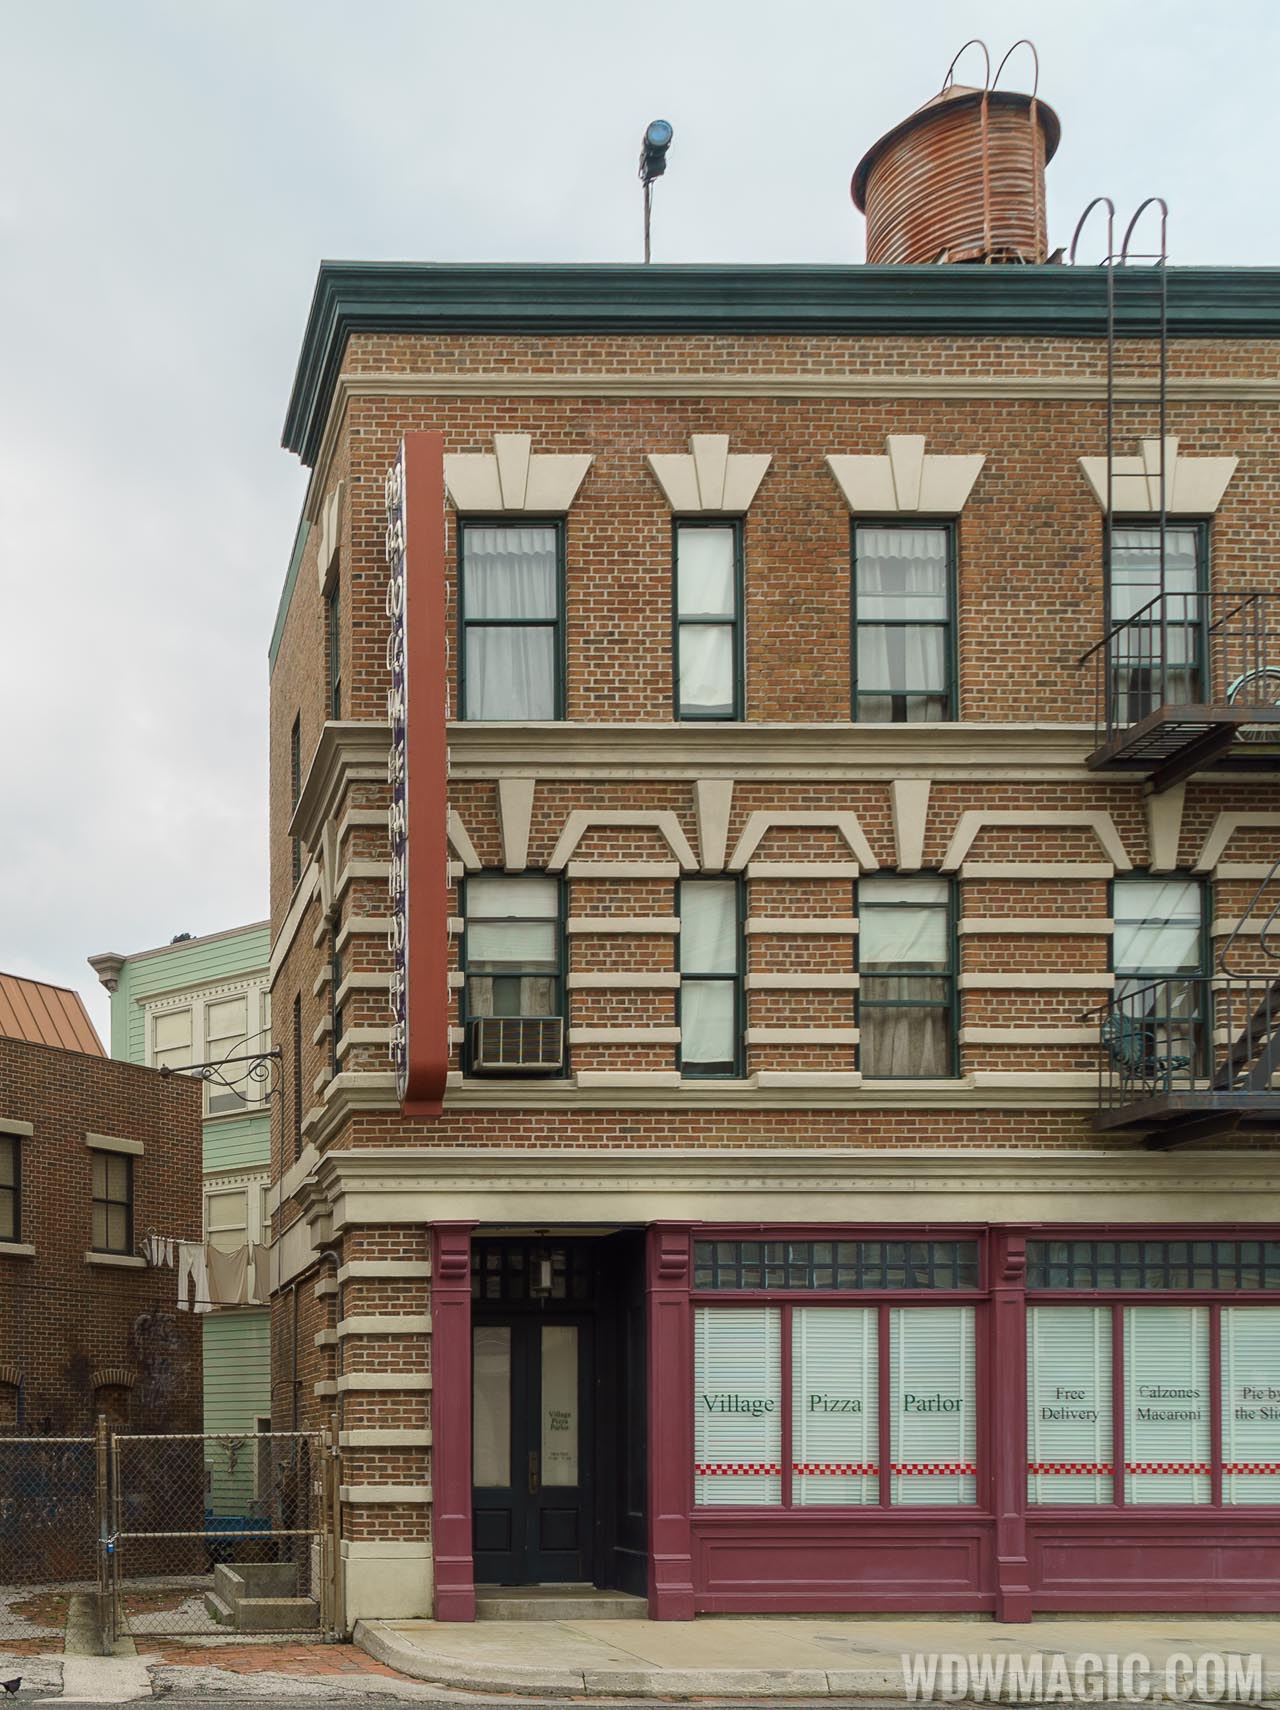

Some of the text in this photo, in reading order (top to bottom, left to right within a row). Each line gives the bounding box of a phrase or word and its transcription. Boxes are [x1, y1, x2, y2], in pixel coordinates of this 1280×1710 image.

[1056, 1387, 1085, 1400] Free
[1139, 1385, 1200, 1399] Calzones
[1243, 1386, 1264, 1399] Pie
[703, 1394, 775, 1417] Village
[810, 1394, 862, 1412] Pizza
[904, 1394, 963, 1412] Parlor
[549, 1410, 571, 1418] Village
[1041, 1407, 1099, 1422] Delivery
[1137, 1408, 1201, 1421] Macaroni
[1235, 1406, 1280, 1420] the Sli
